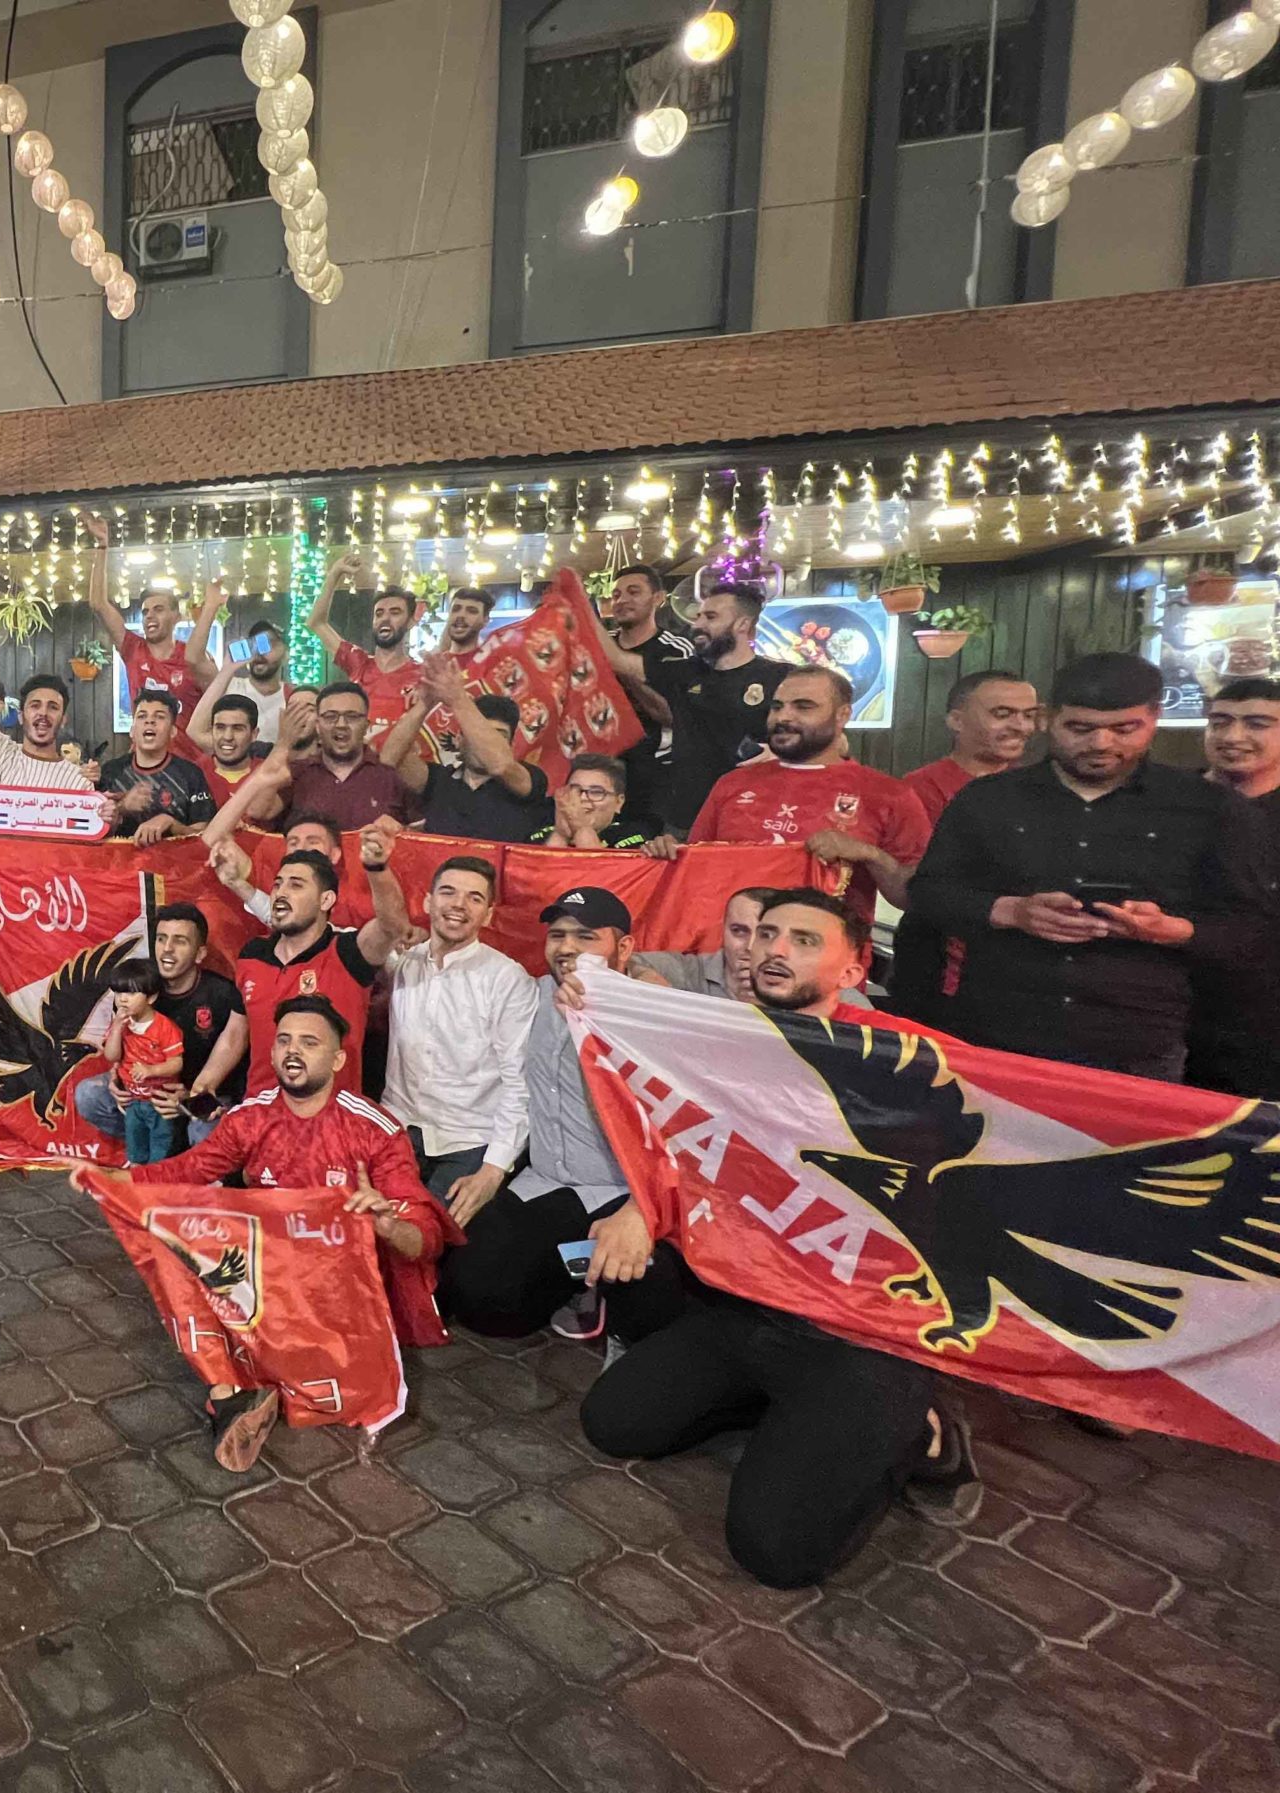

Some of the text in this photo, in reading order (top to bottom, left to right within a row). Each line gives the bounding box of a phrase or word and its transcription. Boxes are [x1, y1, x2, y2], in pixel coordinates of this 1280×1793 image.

[79, 798, 98, 811] ابطة
[10, 816, 63, 830] فلسطين
[762, 818, 799, 834] saib
[46, 1141, 100, 1159] AHLY
